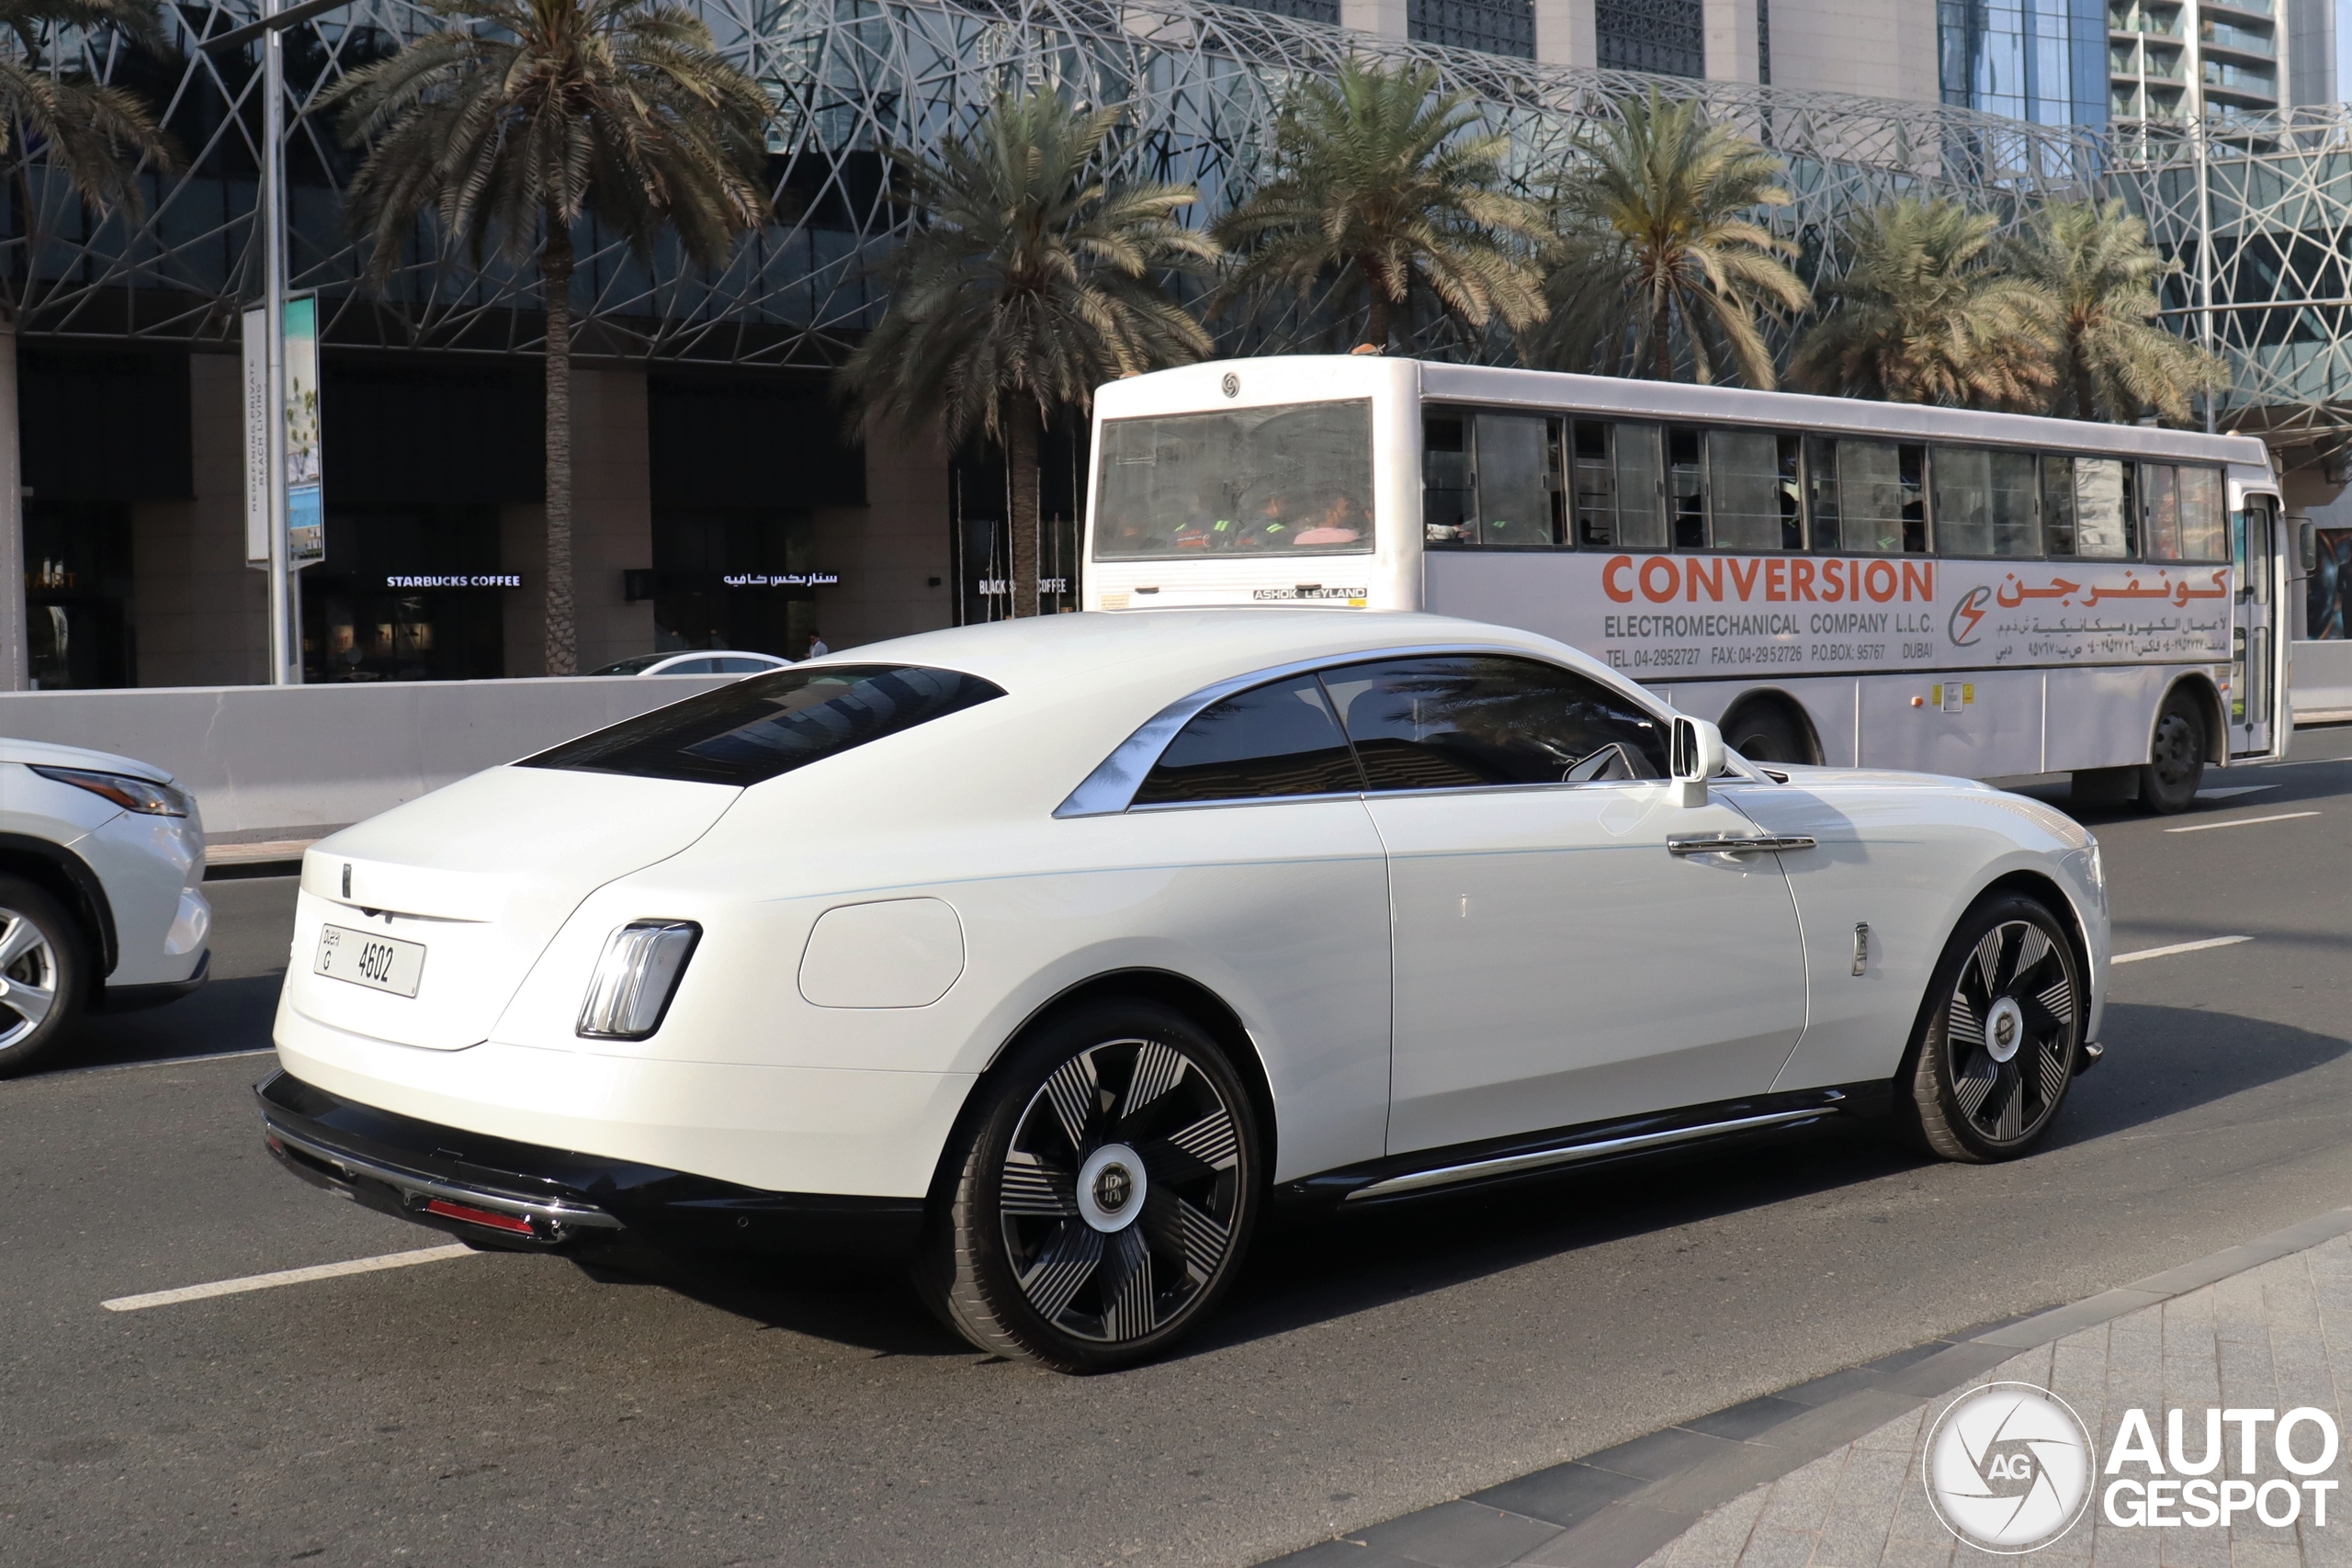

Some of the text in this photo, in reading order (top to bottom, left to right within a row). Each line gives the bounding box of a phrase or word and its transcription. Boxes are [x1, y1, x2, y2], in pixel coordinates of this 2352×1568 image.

[387, 575, 520, 587] STARBUCKS COFFEE
[723, 573, 768, 587] كافيه
[978, 579, 1007, 595] BLACK
[1602, 555, 1933, 604] CONVERSION
[1996, 568, 2228, 608] كونفرجن
[1254, 588, 1365, 600] ASHOK LEYLAND
[1605, 613, 1934, 638] ELECTROMECHANICAL COMPANY L.L.C.
[1606, 649, 1633, 669] TEL.
[1634, 648, 1701, 668] 04-2952727
[1711, 646, 1736, 664] FAX:
[1738, 645, 1802, 664] 04-2952726
[1857, 644, 1885, 660] 95767
[1903, 642, 1933, 659] DUBAI
[323, 942, 394, 983] G 4602
